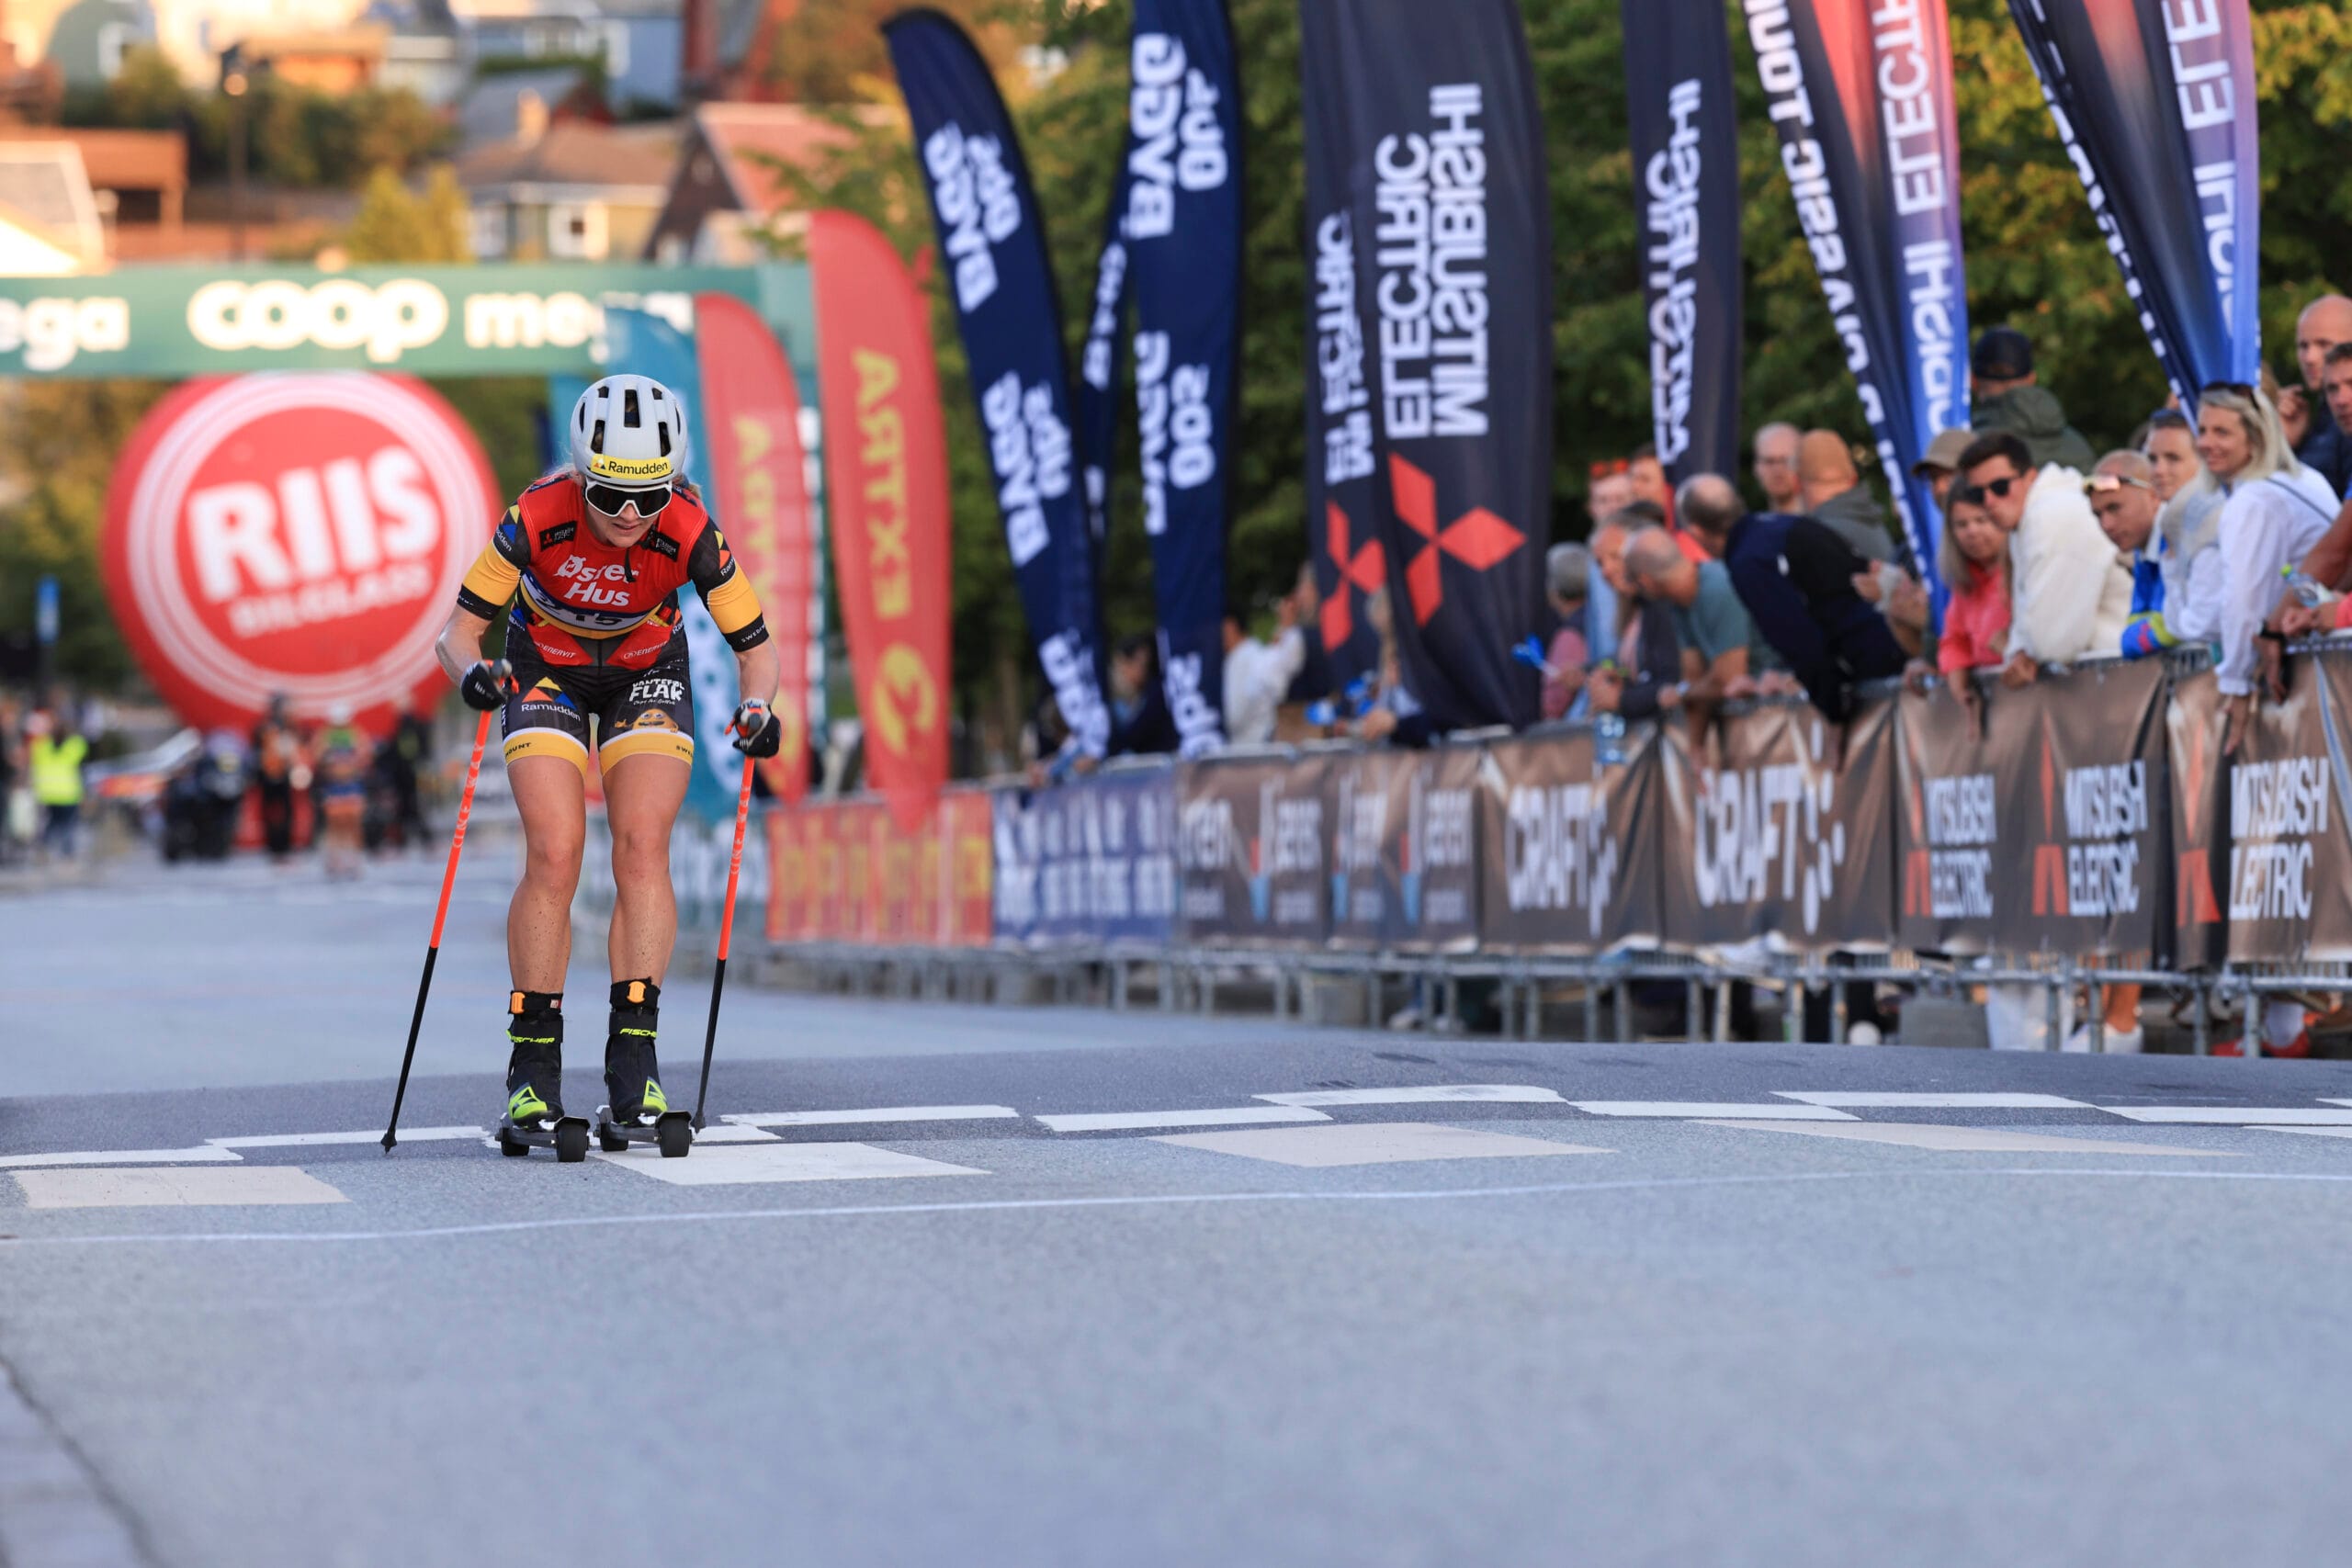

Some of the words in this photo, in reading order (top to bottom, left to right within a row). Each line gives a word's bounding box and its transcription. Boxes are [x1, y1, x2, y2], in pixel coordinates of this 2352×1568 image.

[187, 279, 450, 364] coop
[608, 460, 668, 475] Ramudden
[187, 446, 440, 604] RIIS
[564, 581, 630, 606] Hus
[521, 703, 582, 721] Ramudden
[1505, 783, 1592, 910] CRAFT
[1694, 763, 1803, 908] CRAFT
